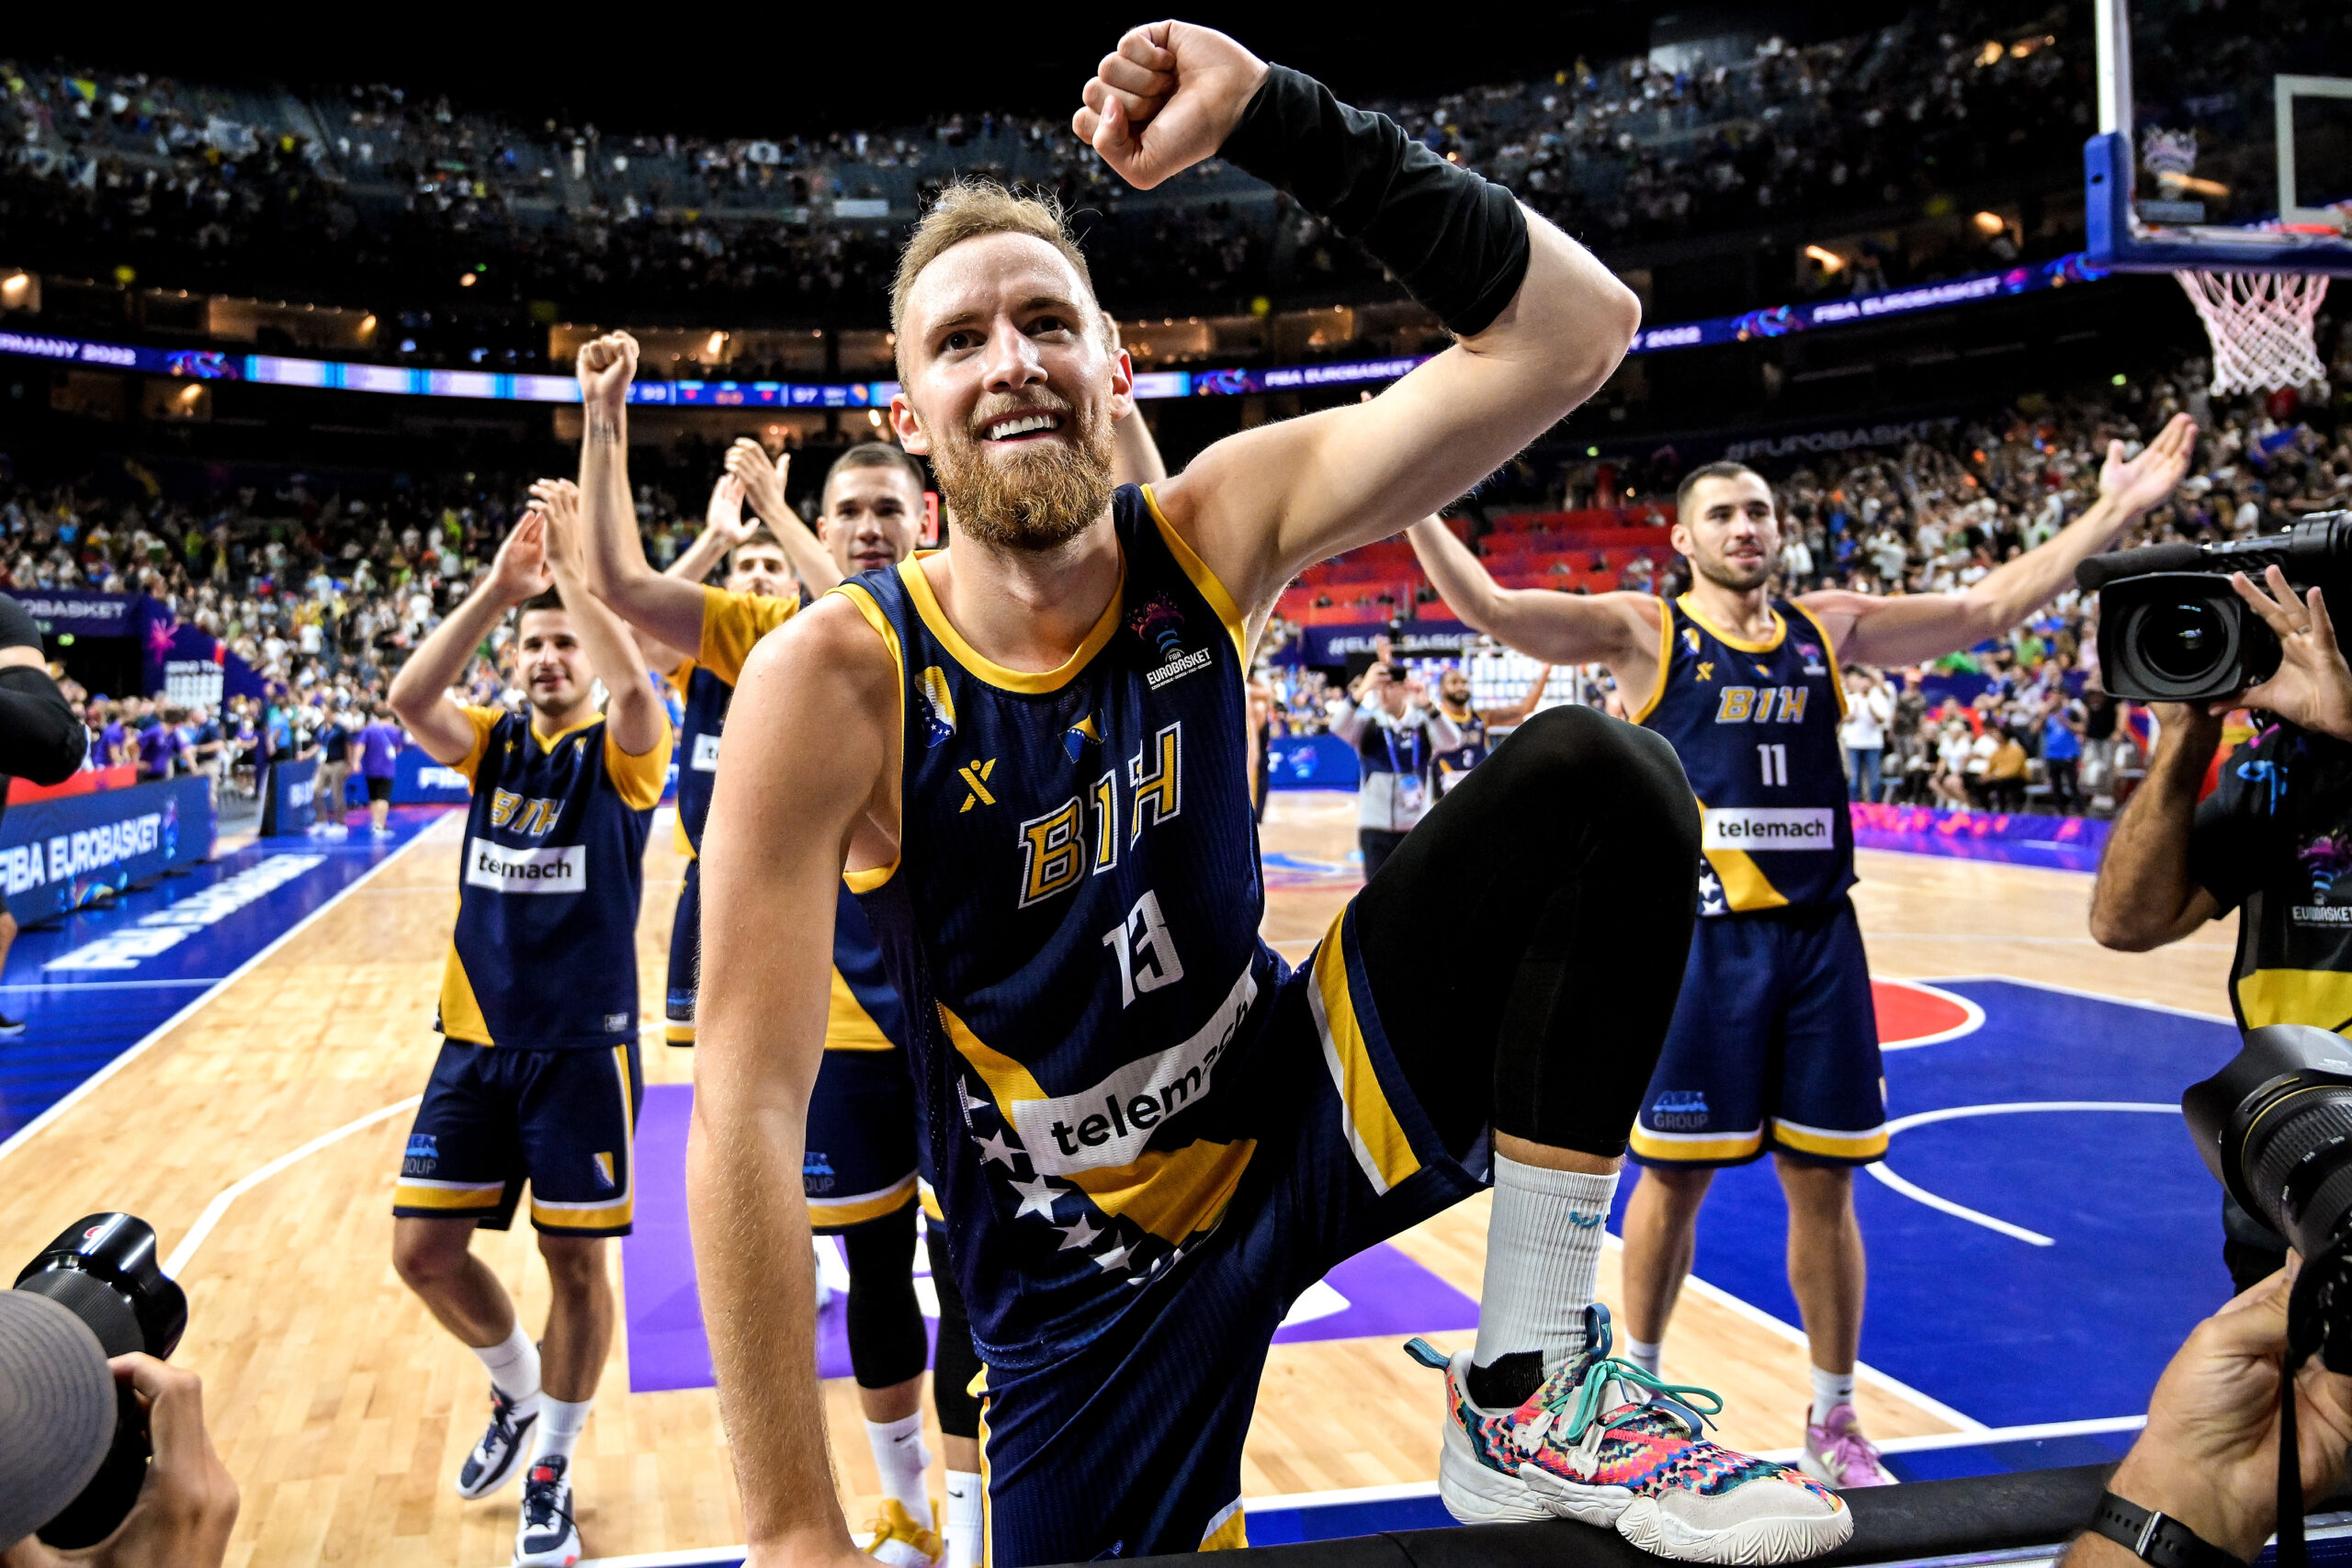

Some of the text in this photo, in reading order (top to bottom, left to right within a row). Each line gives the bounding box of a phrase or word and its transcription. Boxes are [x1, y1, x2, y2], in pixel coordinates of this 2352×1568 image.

[1146, 647, 1211, 685] EUROBASKET
[1169, 651, 1182, 662] FIBA
[1757, 743, 1788, 787] 11
[1717, 818, 1826, 839] telemach
[0, 812, 162, 897] FIBA EUROBASKET
[1102, 888, 1185, 1010] 13
[1050, 999, 1249, 1156] telemach
